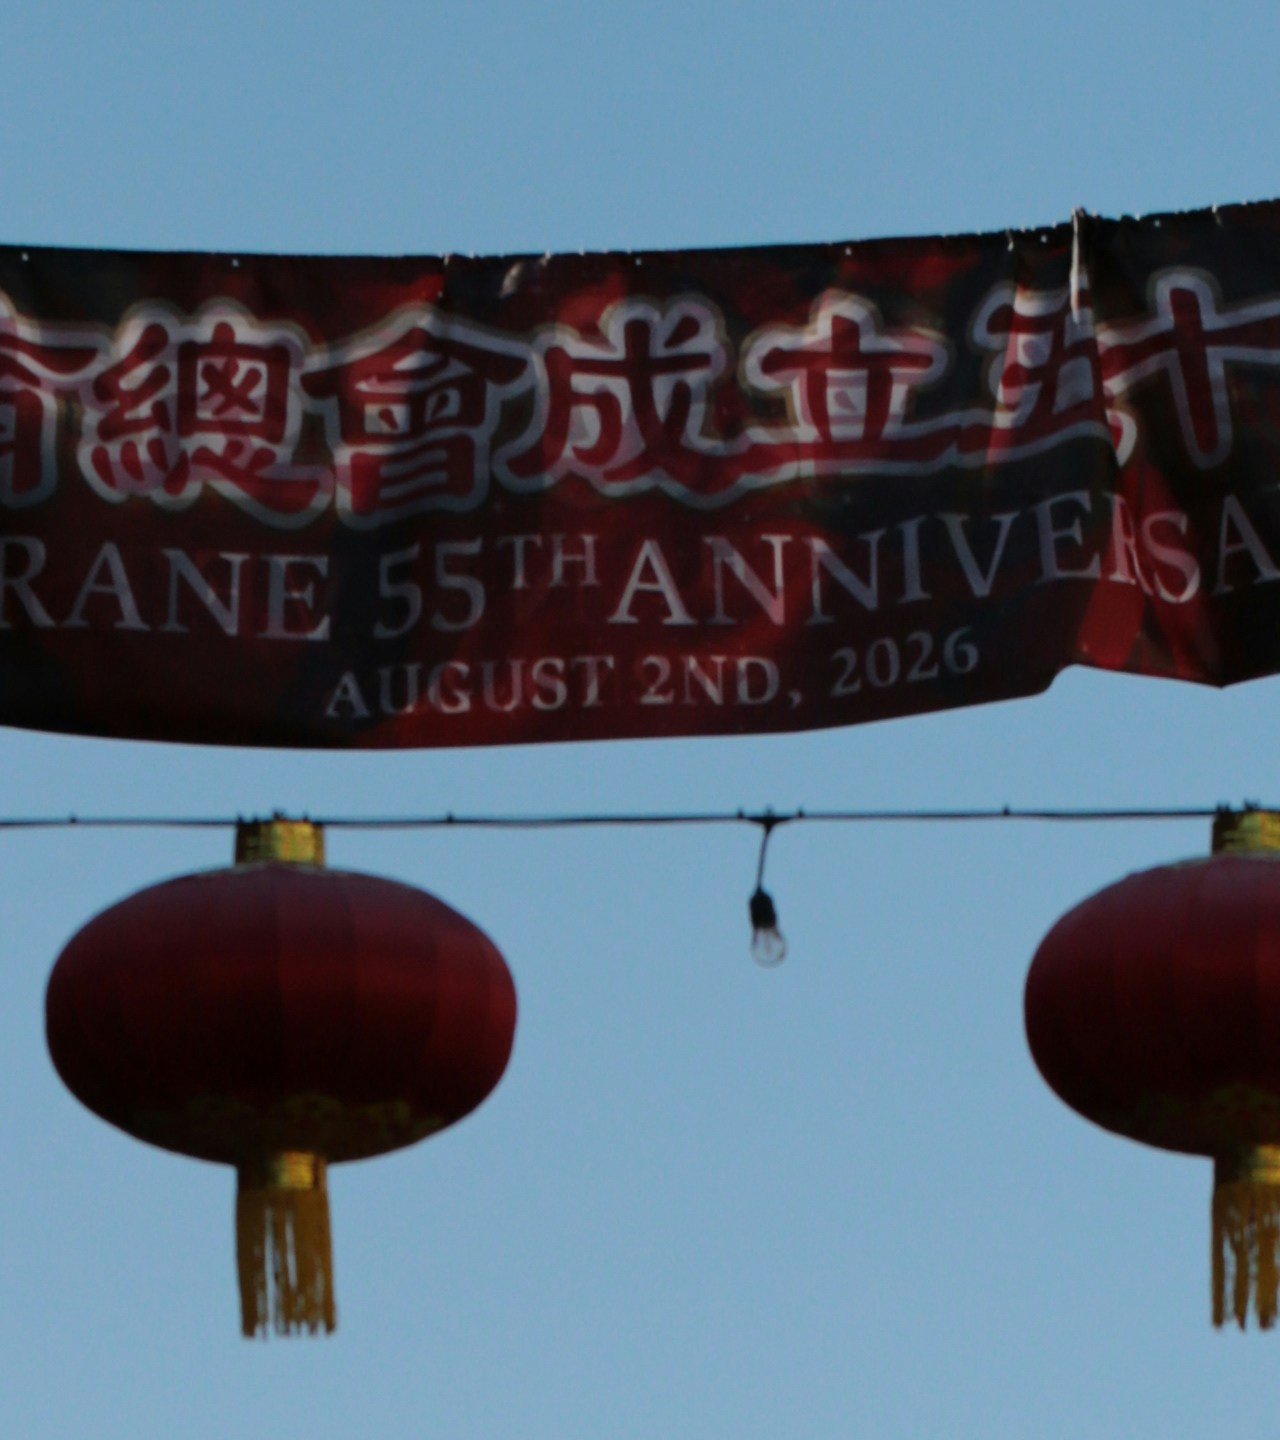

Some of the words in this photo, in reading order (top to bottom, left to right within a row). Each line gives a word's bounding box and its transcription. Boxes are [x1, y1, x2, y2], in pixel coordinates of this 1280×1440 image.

[325, 652, 615, 721] AUGUST
[640, 654, 805, 713] 2ND,
[830, 624, 981, 699] 2026
